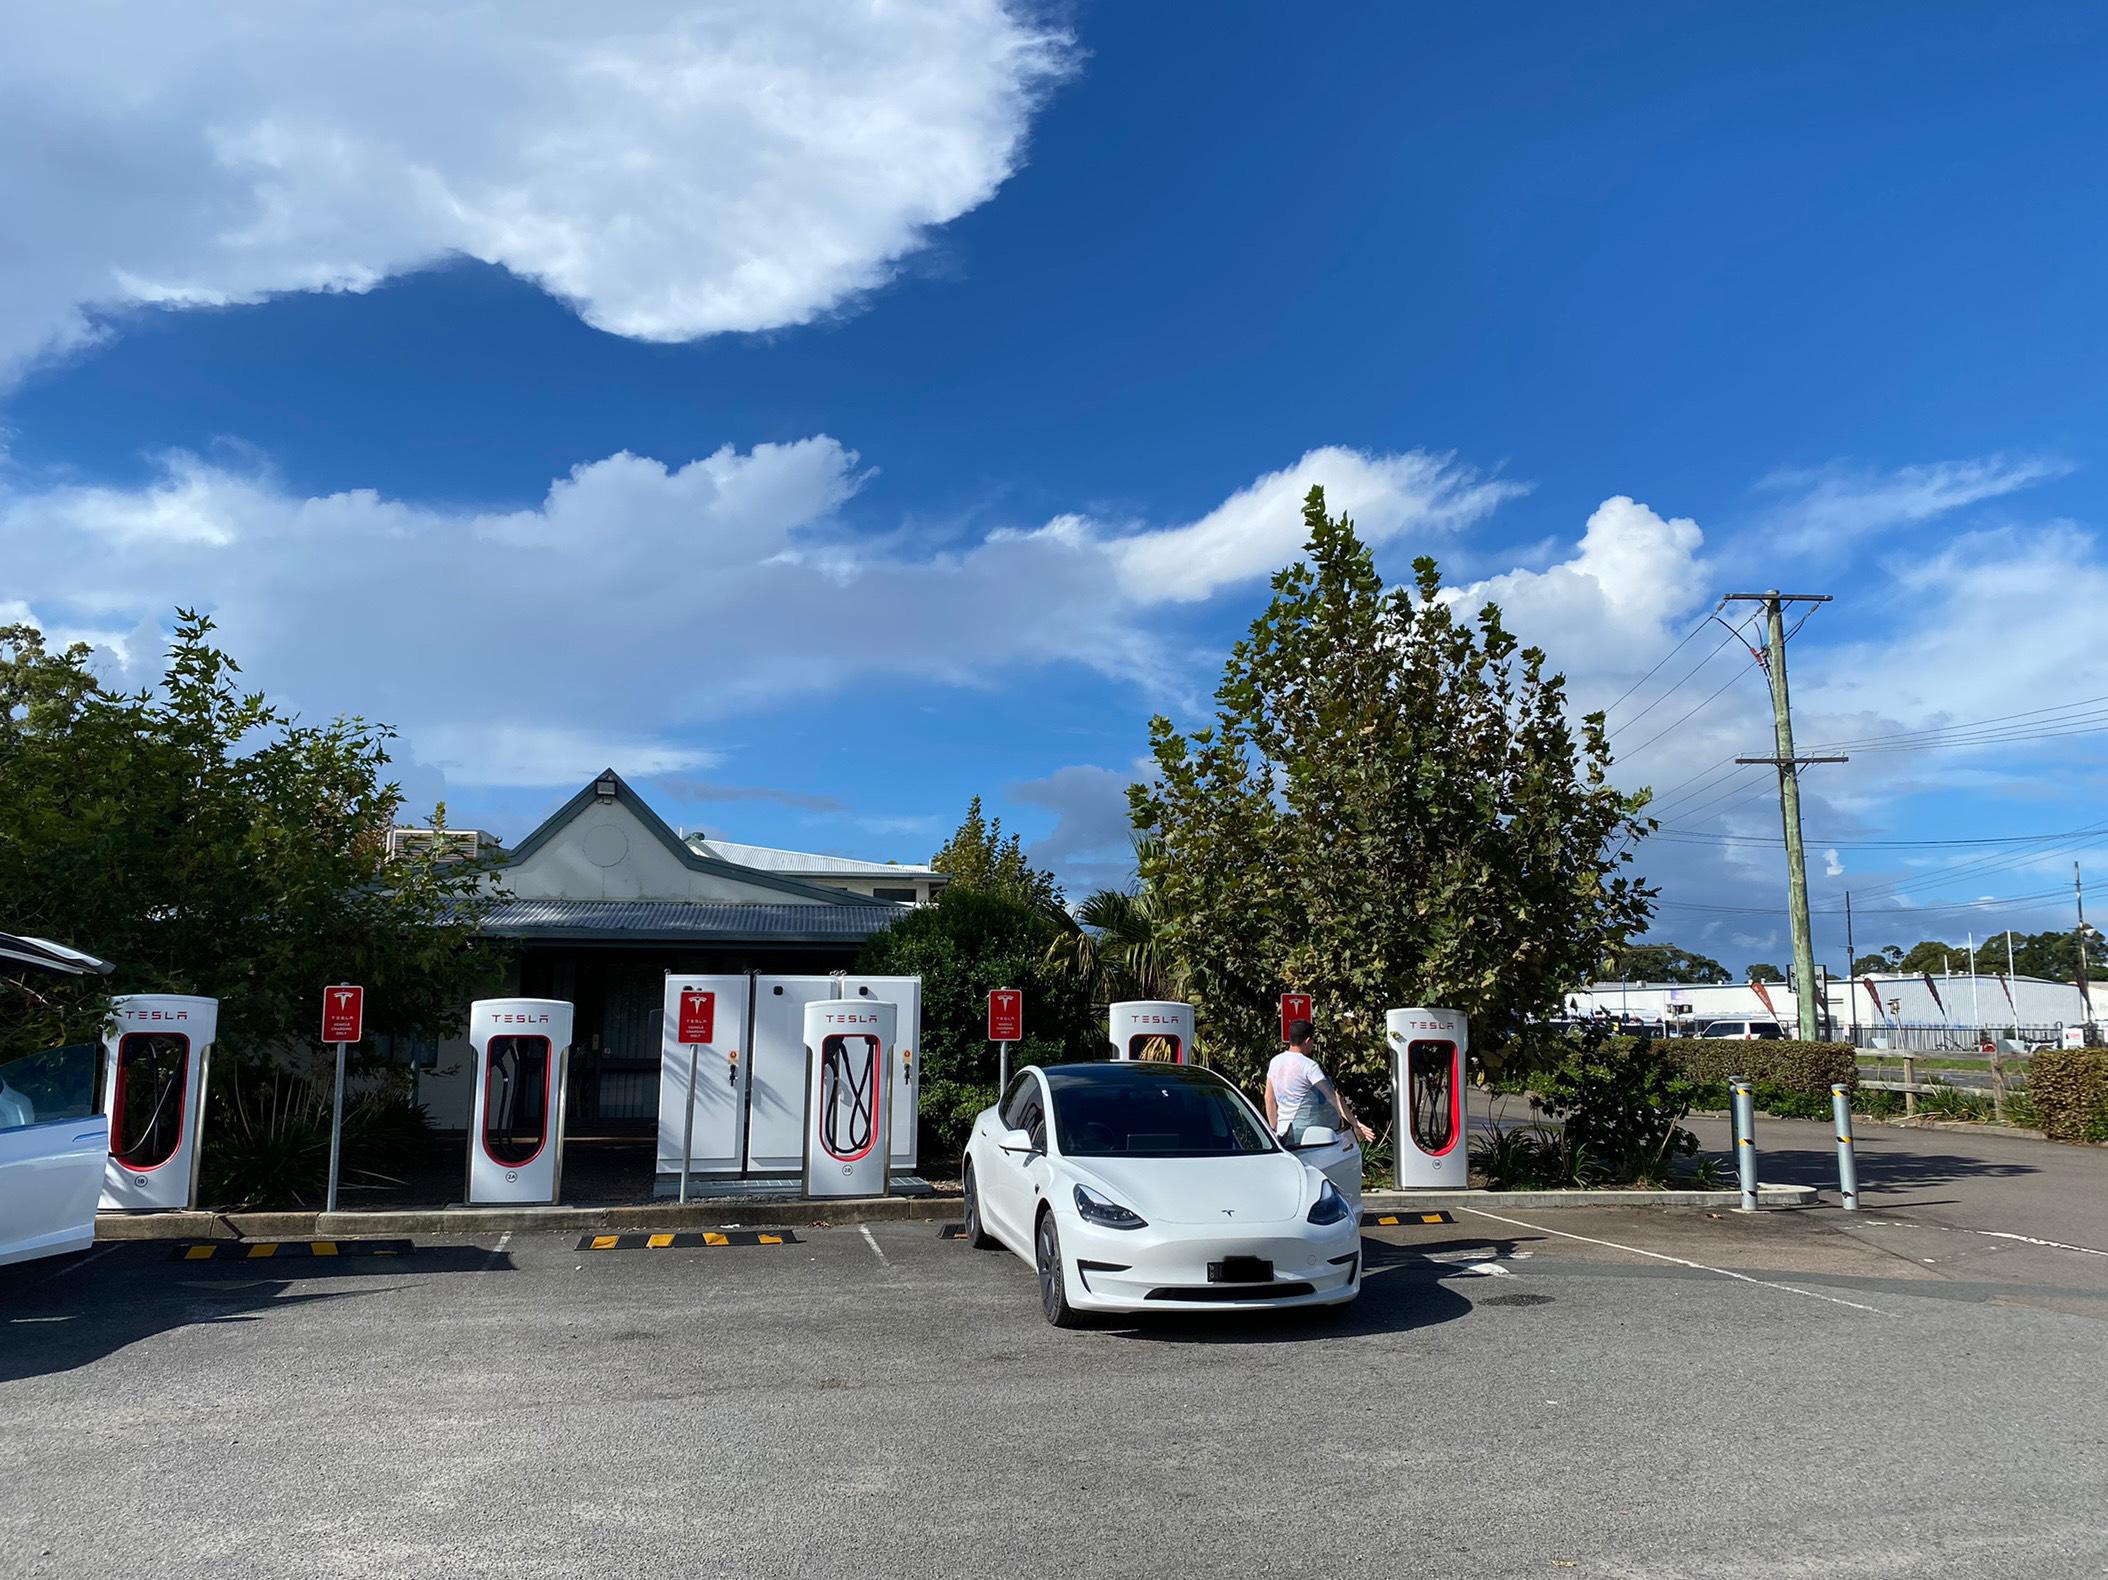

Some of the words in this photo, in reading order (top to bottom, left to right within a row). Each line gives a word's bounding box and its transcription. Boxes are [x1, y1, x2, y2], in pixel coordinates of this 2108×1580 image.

[125, 1011, 188, 1020] TESLA
[491, 1014, 549, 1023] TESLA
[825, 1014, 878, 1023] TESLA
[1131, 1015, 1179, 1024] TESLA
[1409, 1021, 1454, 1030] TESLA
